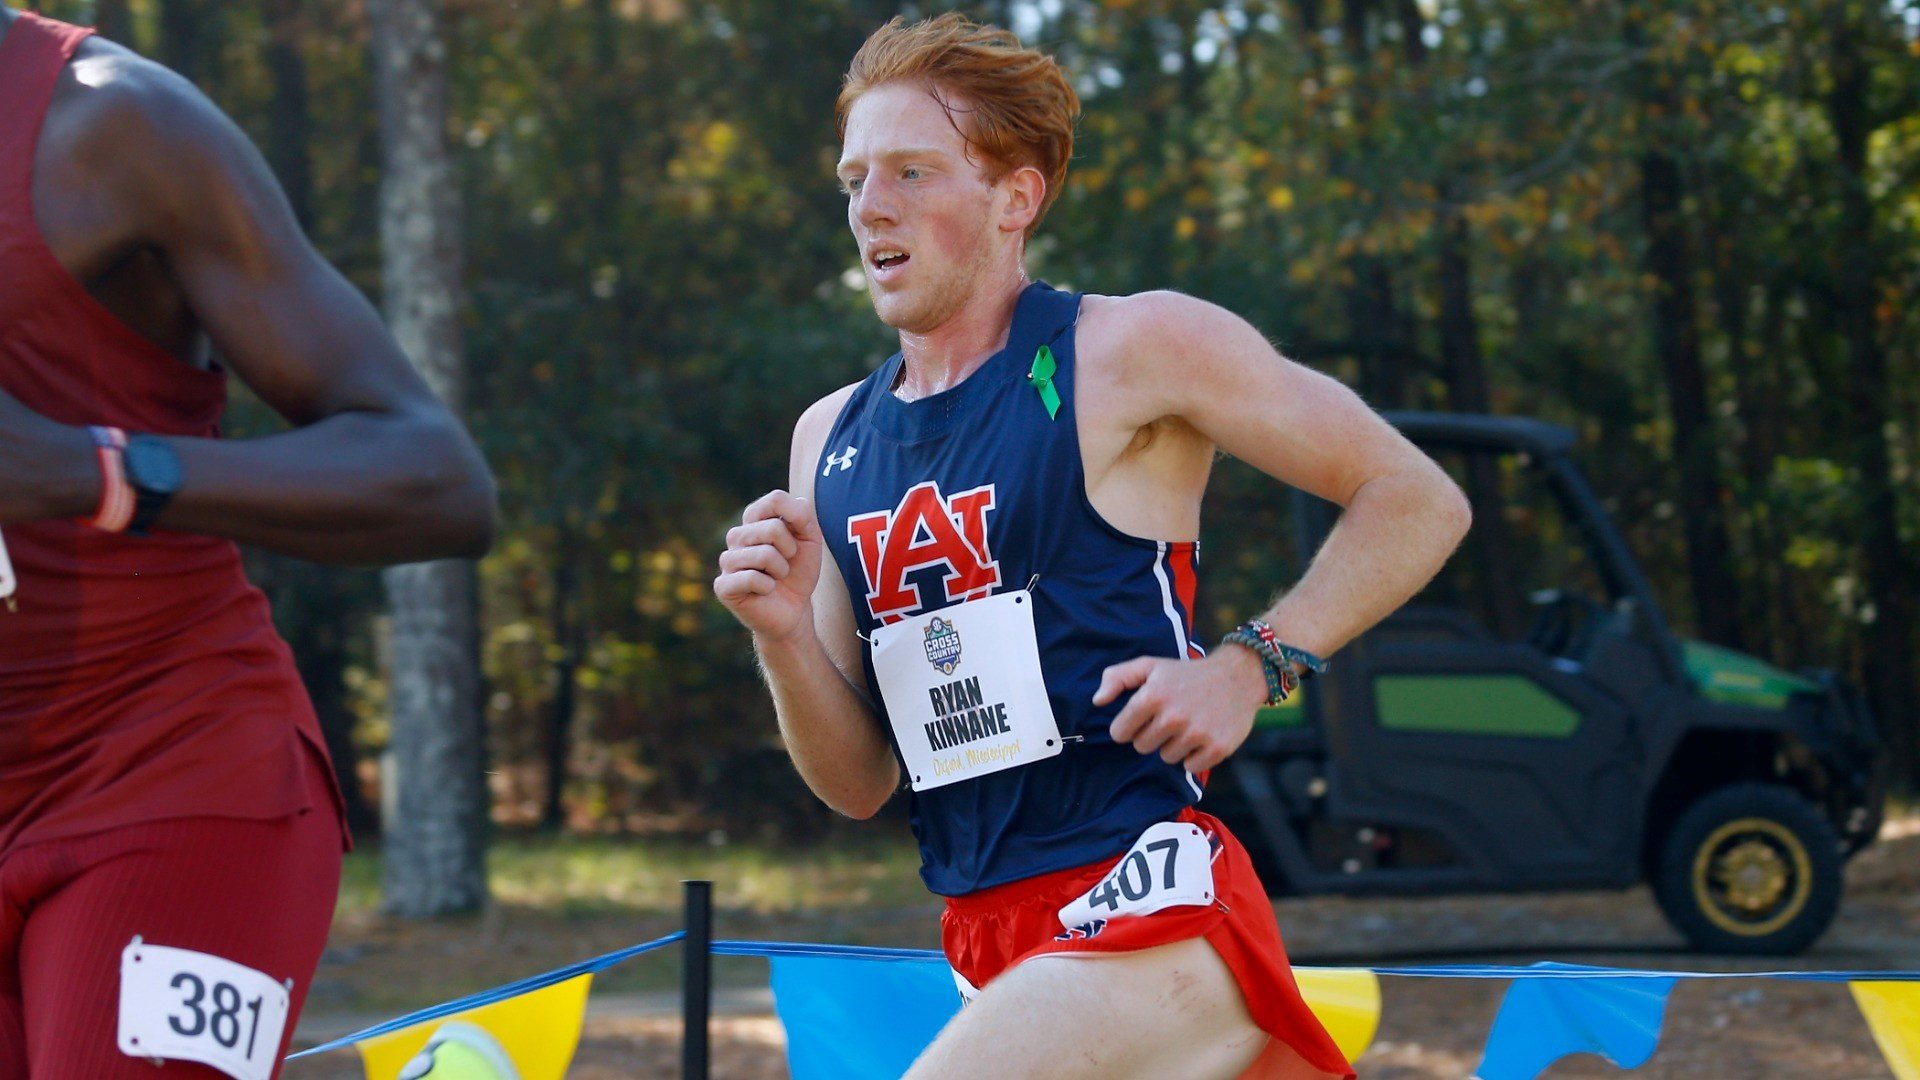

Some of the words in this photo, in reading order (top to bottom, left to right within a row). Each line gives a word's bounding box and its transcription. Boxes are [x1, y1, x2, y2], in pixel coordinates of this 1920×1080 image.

[925, 633, 959, 652] CROSS
[928, 645, 960, 660] COUNTRY
[928, 676, 984, 717] RYAN
[924, 702, 1011, 752] KINNANE
[966, 739, 1021, 768] Mississippi
[1088, 838, 1180, 912] 407
[168, 972, 263, 1060] 381
